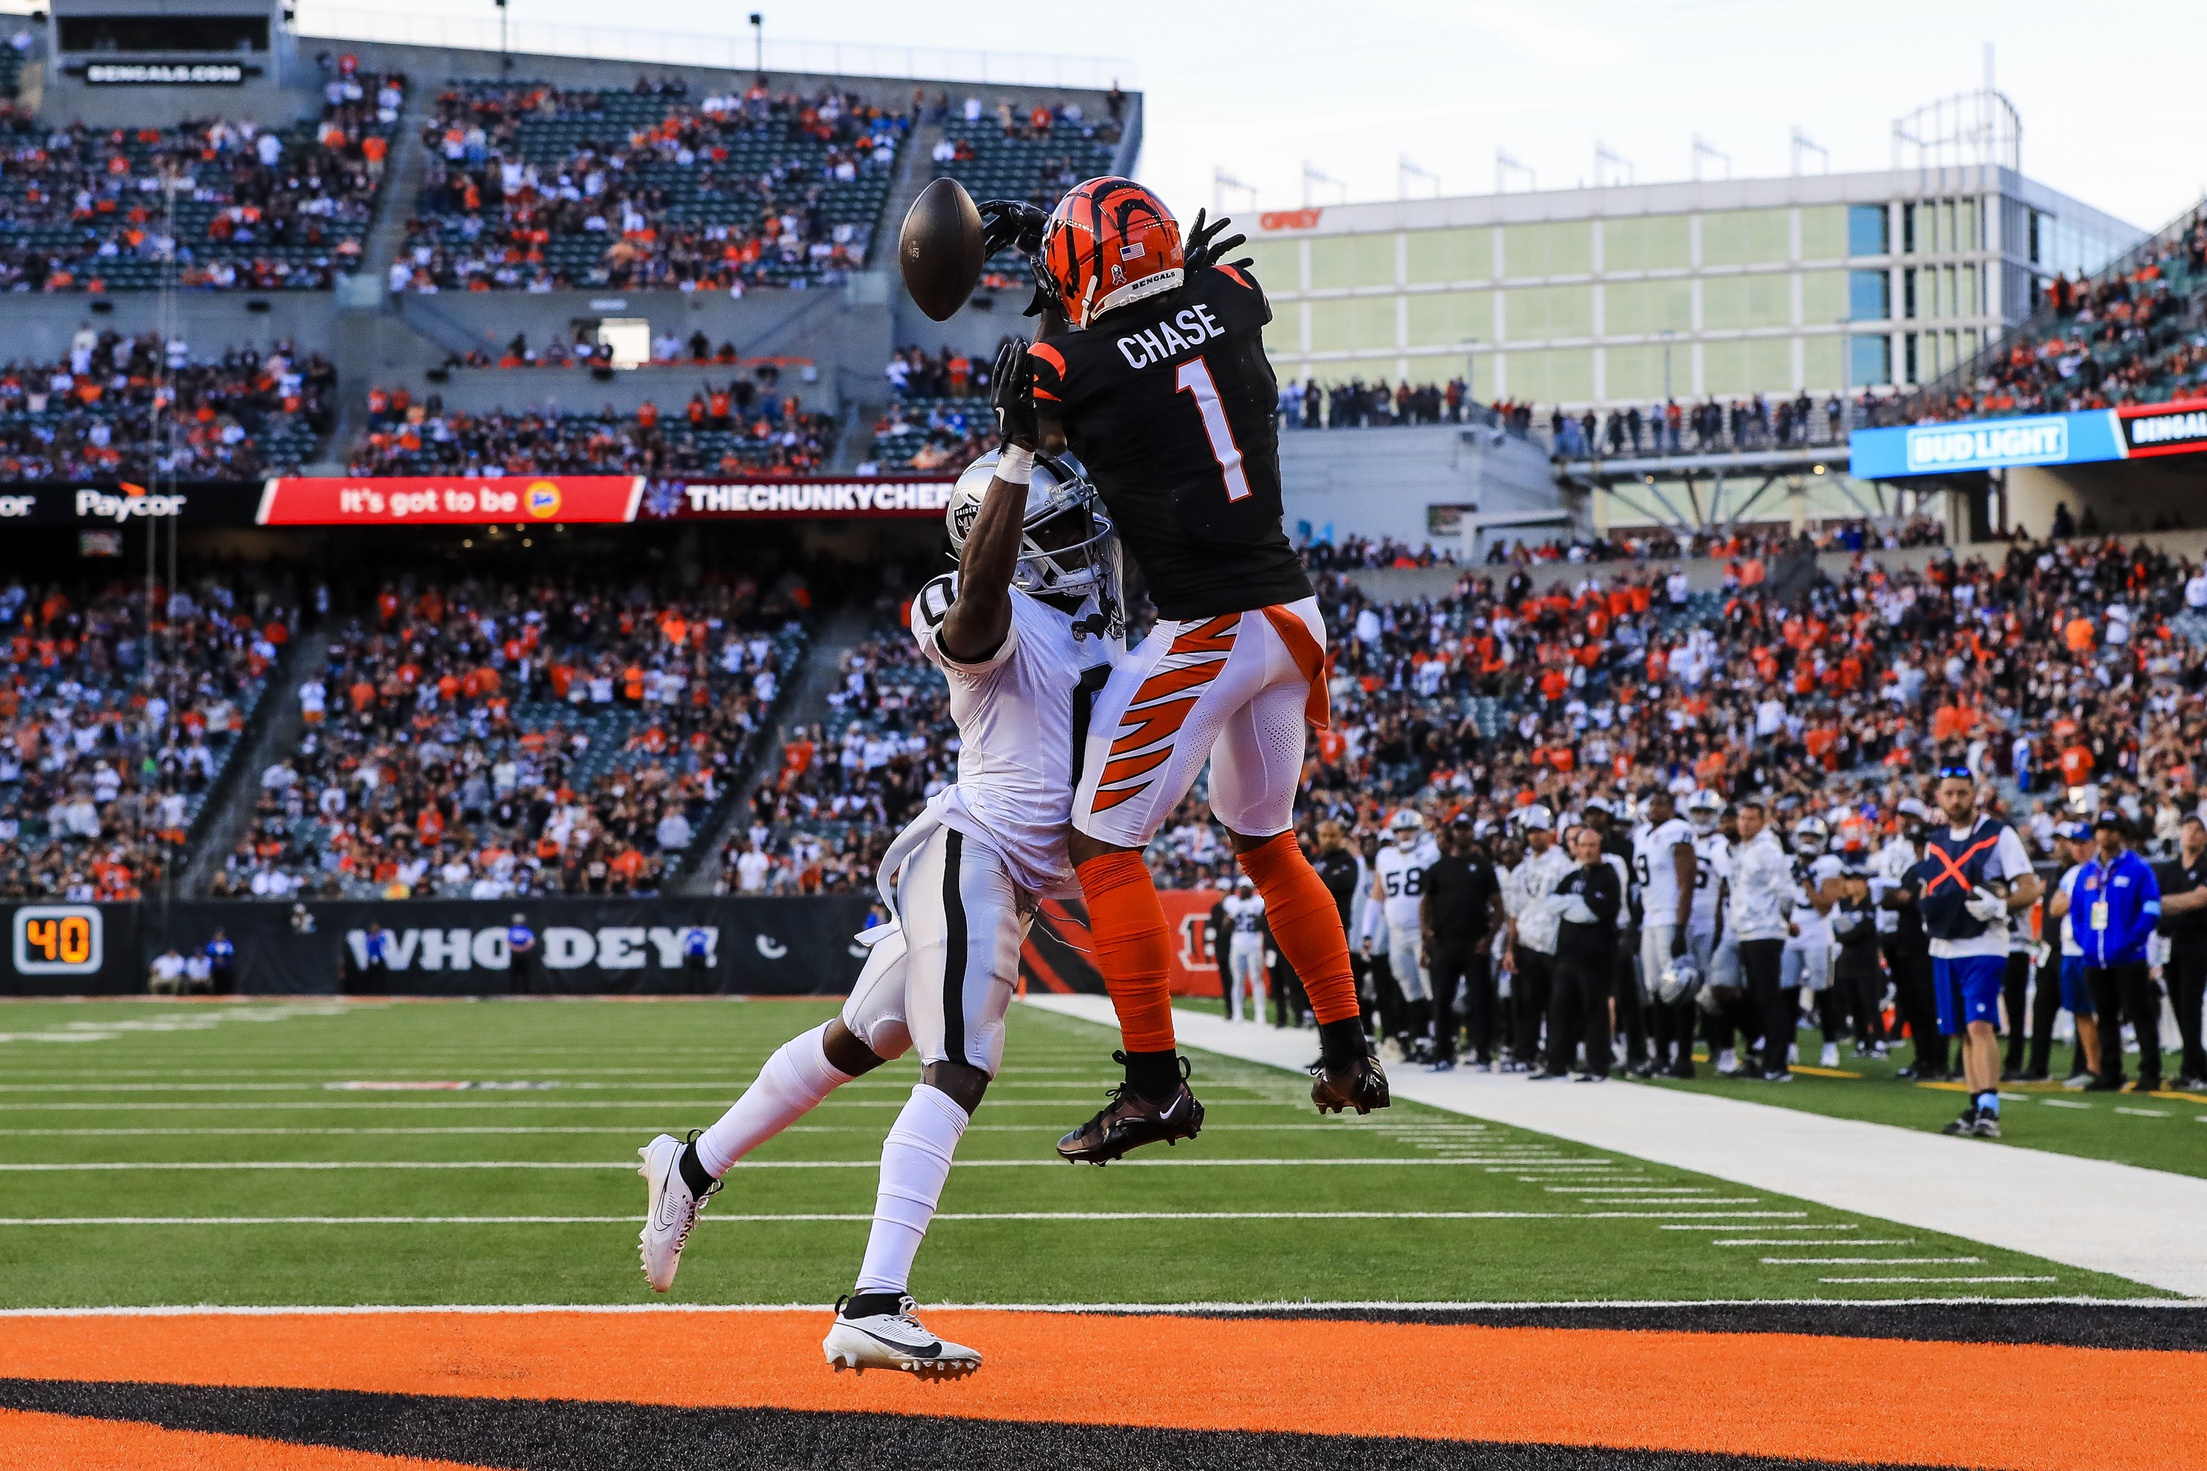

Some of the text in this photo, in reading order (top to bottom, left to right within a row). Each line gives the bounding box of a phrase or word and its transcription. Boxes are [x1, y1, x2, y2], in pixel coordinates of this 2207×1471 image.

[1131, 271, 1176, 291] BENGALS
[1116, 302, 1226, 370] CHASE
[1175, 354, 1253, 504] 1
[1914, 425, 2061, 464] BUD LIGHT
[75, 488, 188, 523] Paycor
[340, 487, 385, 513] It's
[389, 488, 439, 517] got
[444, 488, 476, 512] to
[480, 486, 518, 512] be
[1386, 867, 1428, 897] 58
[27, 916, 90, 964] 40
[346, 927, 513, 971] WHO
